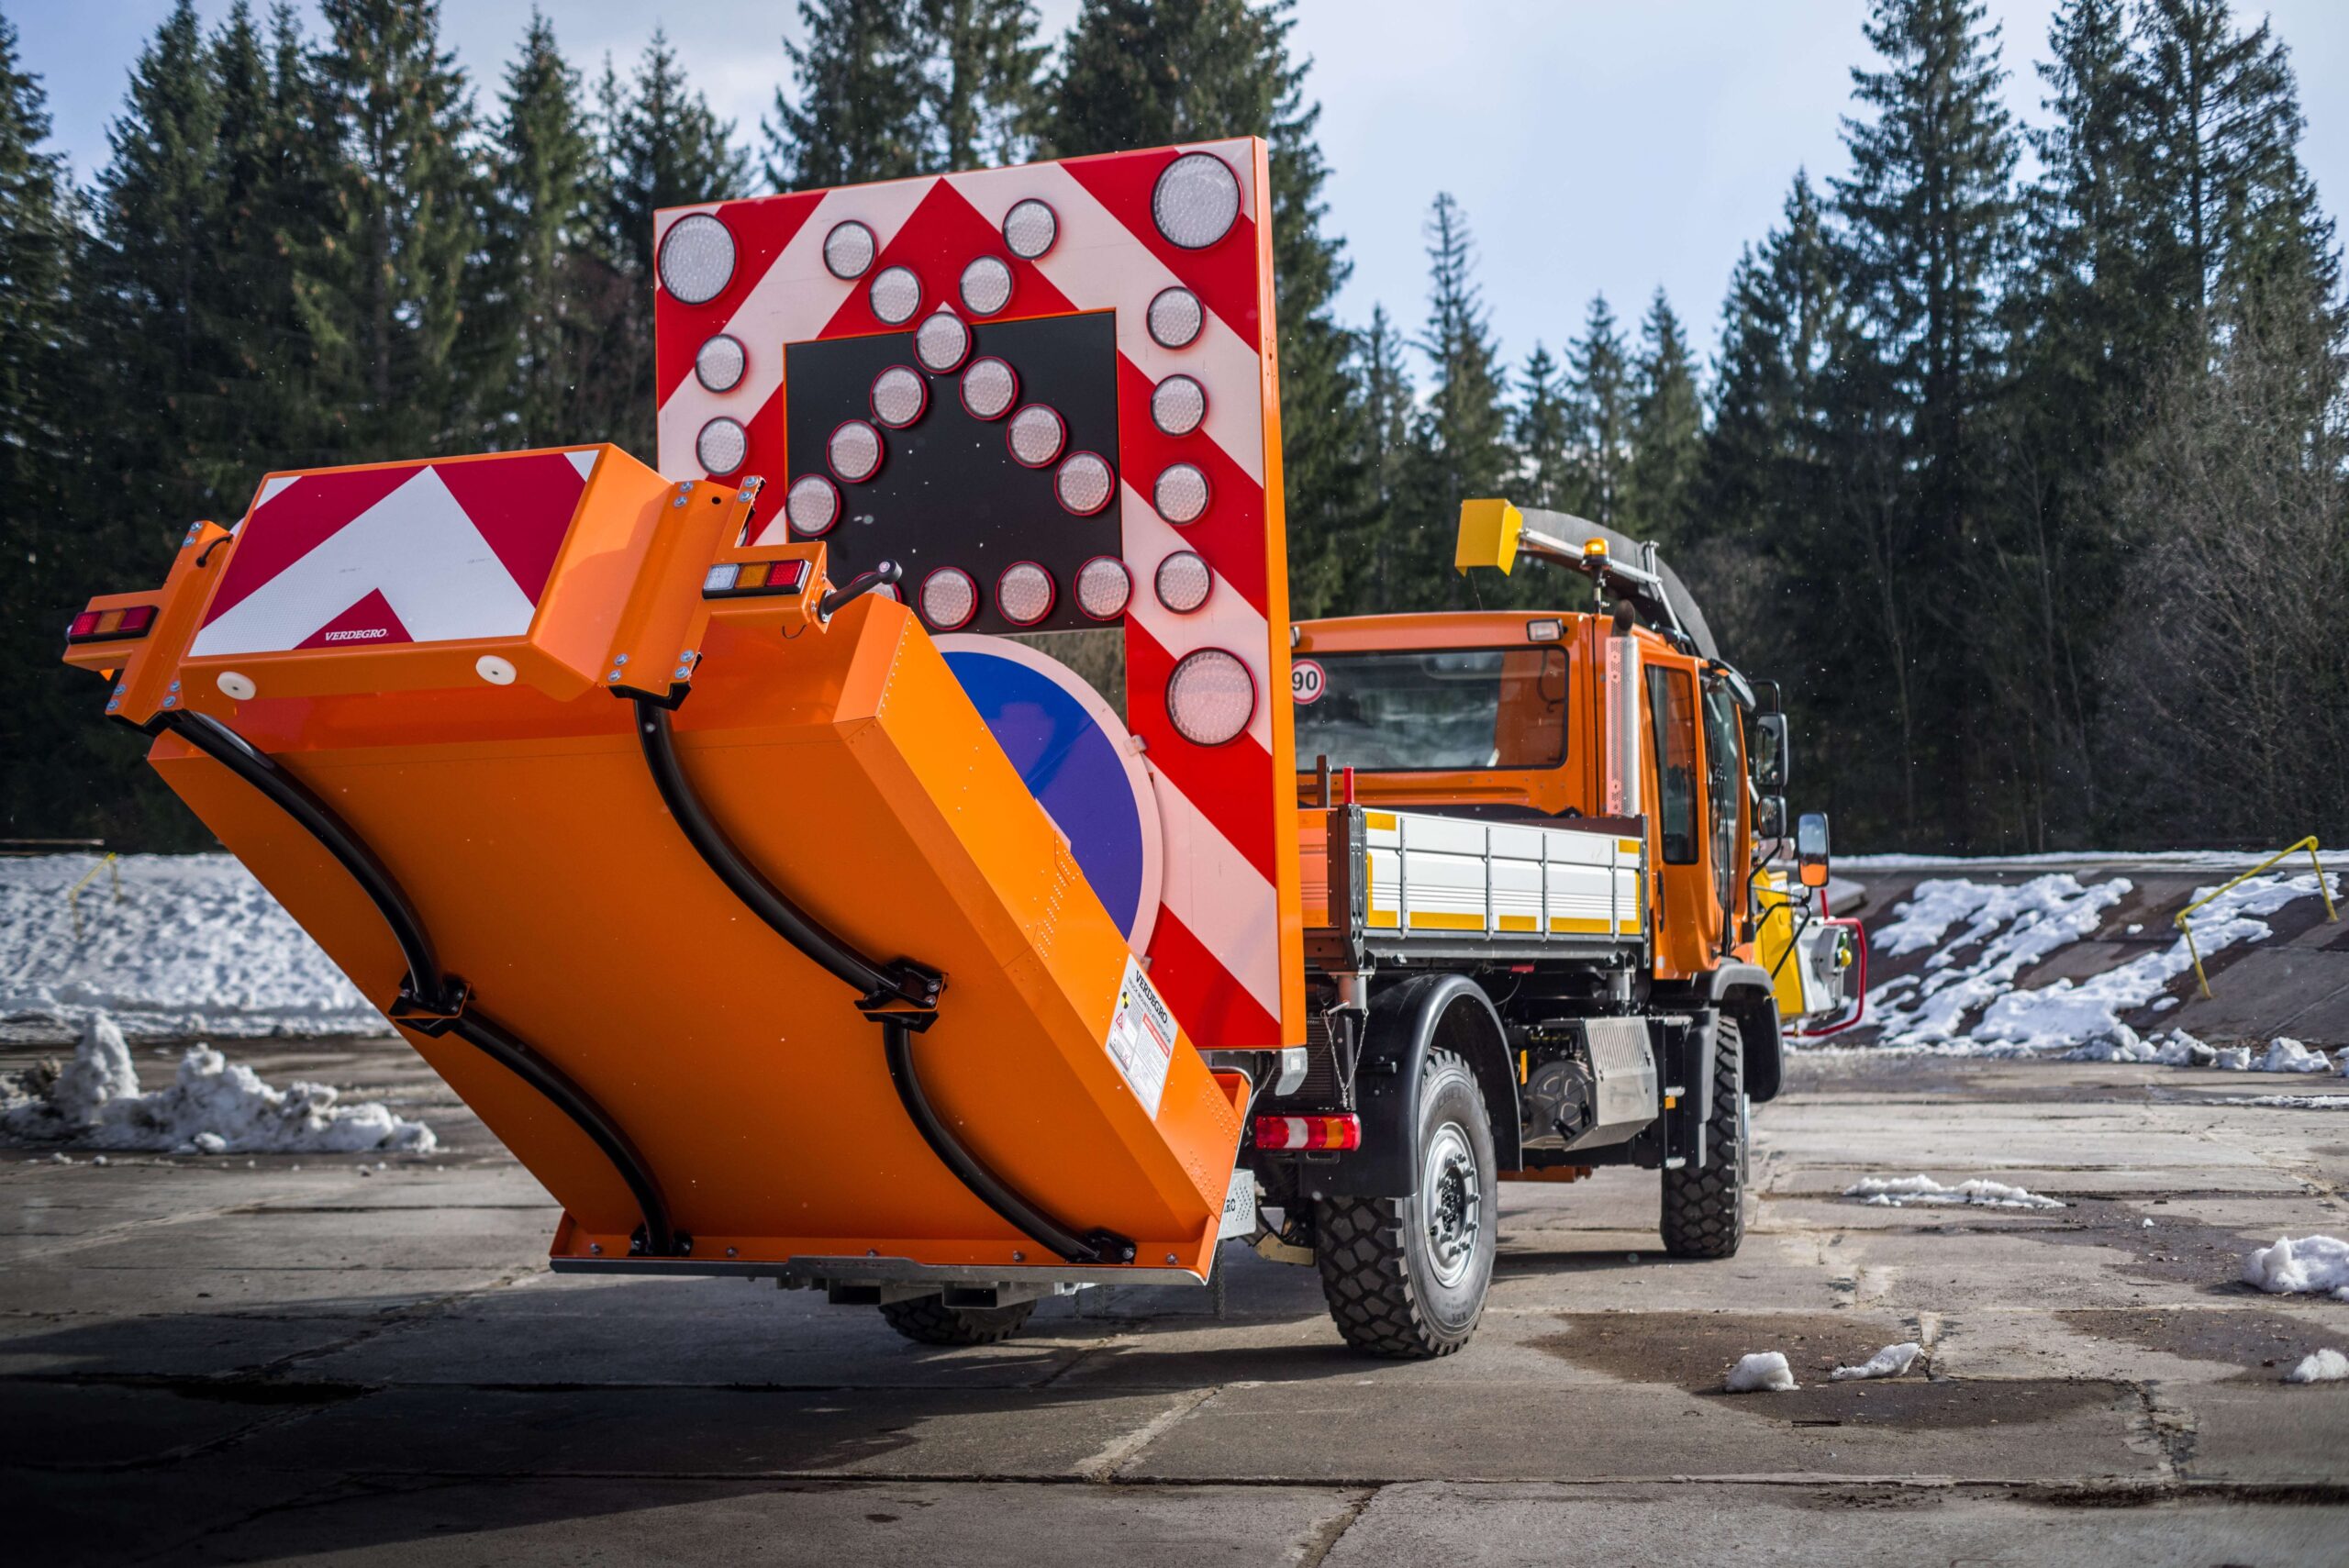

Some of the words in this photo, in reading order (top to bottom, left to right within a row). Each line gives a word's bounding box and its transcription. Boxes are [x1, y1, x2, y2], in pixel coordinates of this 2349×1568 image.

[325, 628, 387, 640] VERDEGRO
[1292, 671, 1318, 691] 90
[1136, 970, 1167, 1024] VERDEGRO
